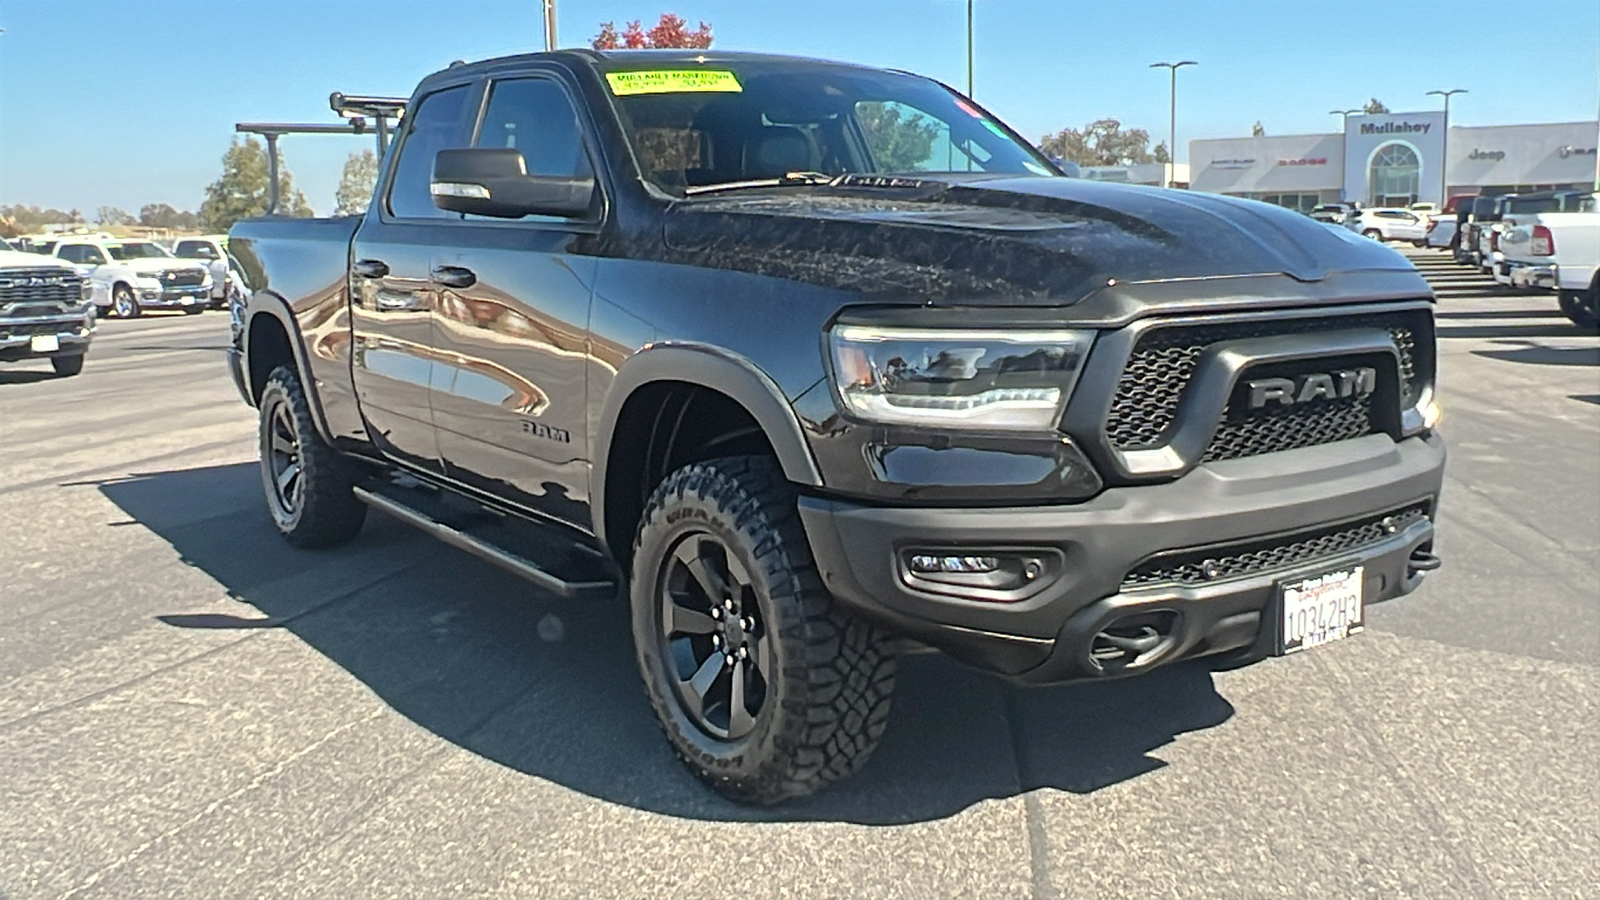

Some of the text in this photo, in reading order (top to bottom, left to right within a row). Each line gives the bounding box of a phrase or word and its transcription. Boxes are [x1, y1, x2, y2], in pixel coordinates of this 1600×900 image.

[1361, 121, 1431, 134] Mullahey
[1468, 148, 1505, 161] Jeep
[1248, 367, 1376, 408] RAM
[519, 418, 571, 444] RAM
[1288, 594, 1357, 641] 10342H3
